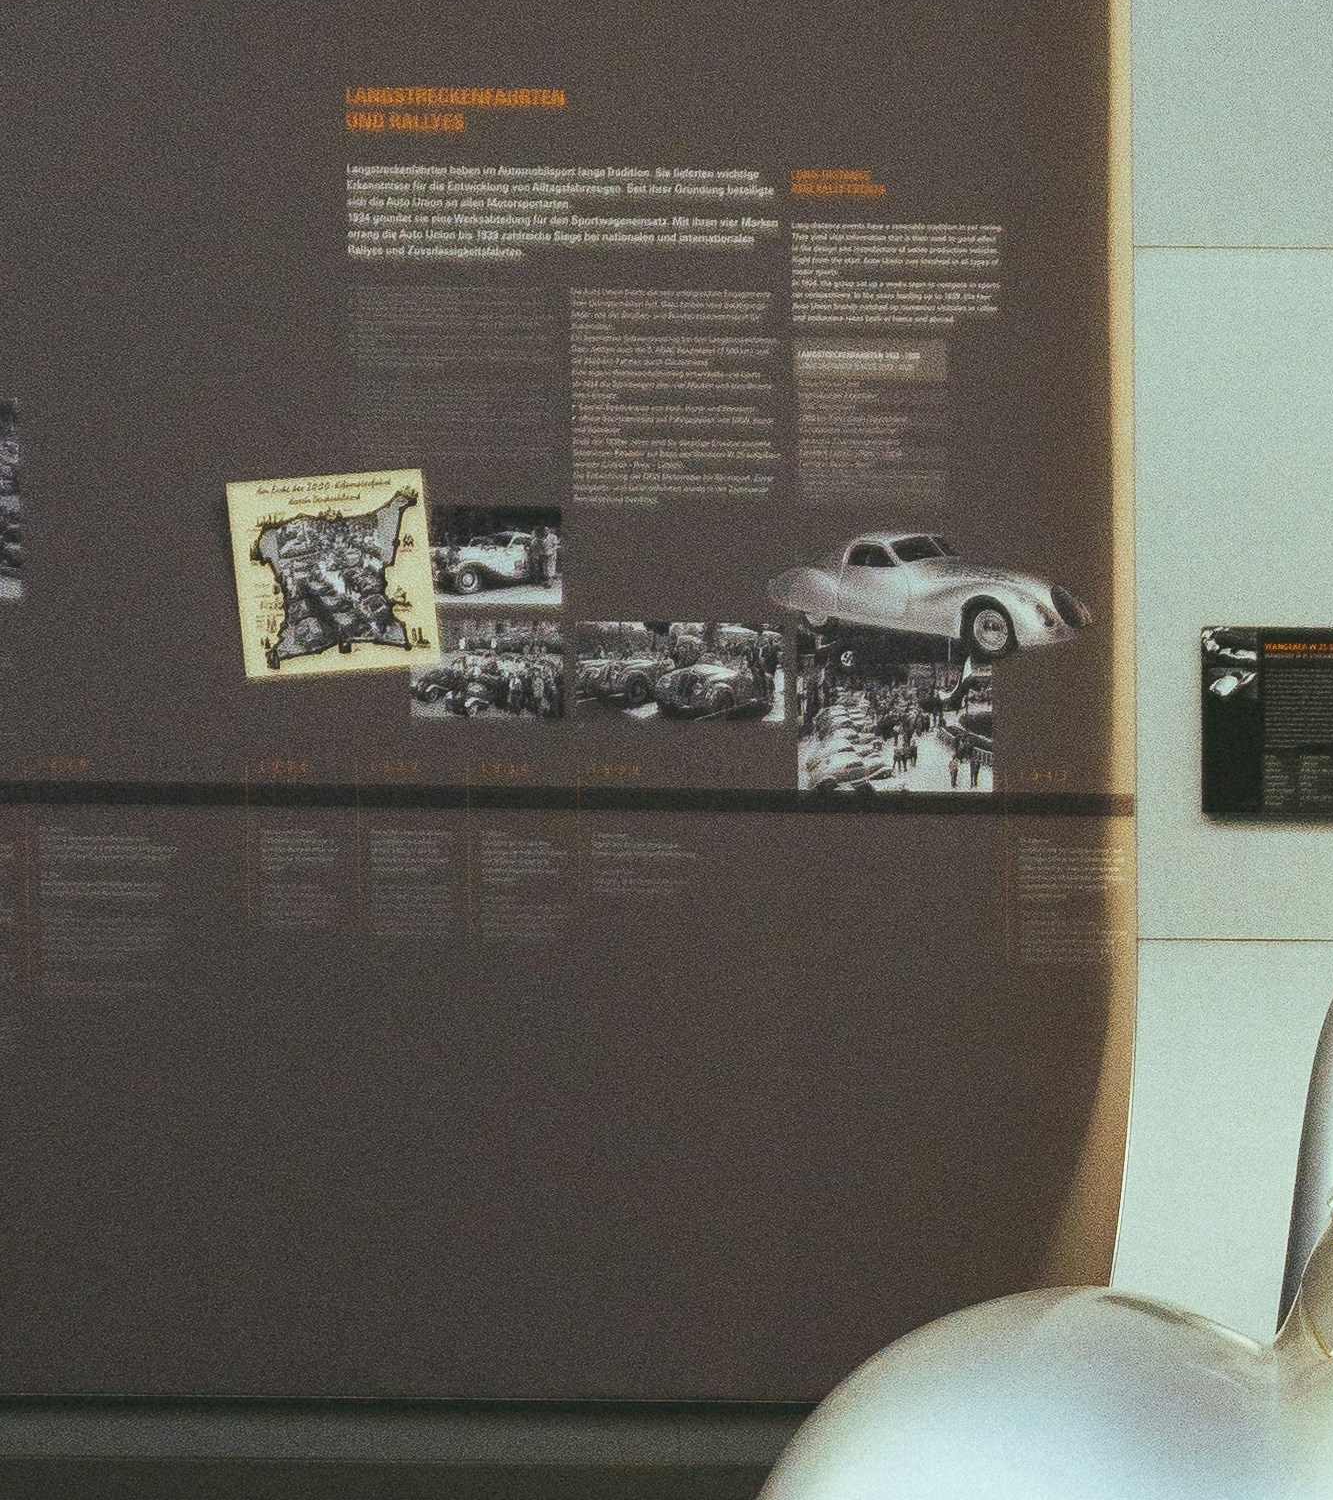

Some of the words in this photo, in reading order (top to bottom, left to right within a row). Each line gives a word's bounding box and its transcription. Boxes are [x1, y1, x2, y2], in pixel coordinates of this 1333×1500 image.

[346, 86, 566, 106] LANGSTRECKENFAHRTEN
[346, 112, 384, 131] UND
[389, 112, 465, 131] RALLYES
